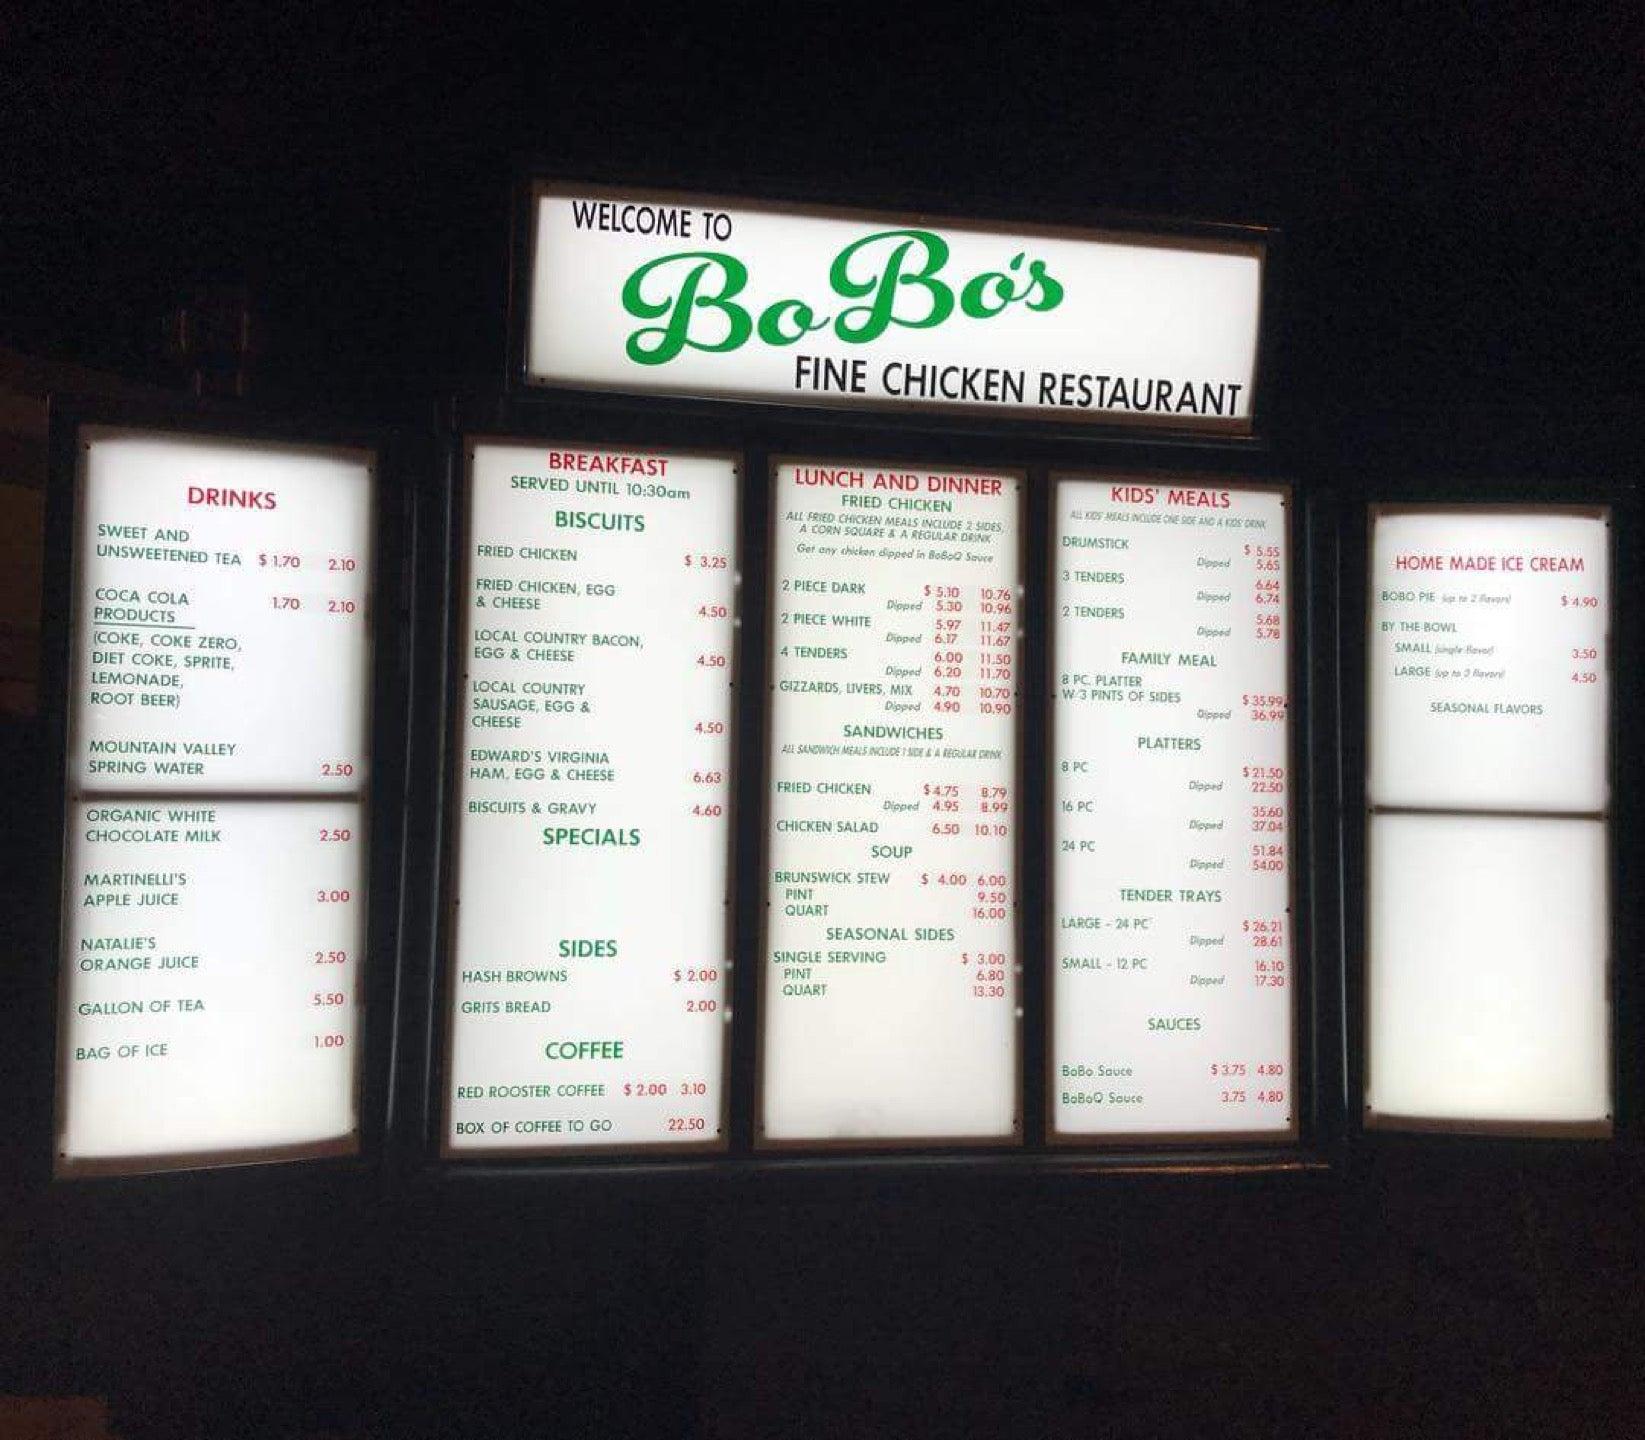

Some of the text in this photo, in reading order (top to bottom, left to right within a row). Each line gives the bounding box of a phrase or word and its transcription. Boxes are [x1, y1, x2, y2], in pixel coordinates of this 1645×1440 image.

[573, 201, 731, 241] WELCOME TO
[622, 230, 1064, 366] BoBo's
[796, 356, 1241, 415] FINE CHICKEN RESTAURANT
[550, 453, 667, 476] BREAKFAST
[512, 476, 690, 498] SERVED UNTIL 10:30am
[796, 469, 1001, 495] LUNCH AND DINNER
[189, 487, 276, 509] DRINKS
[842, 494, 952, 512] FRIED CHICKEN
[1112, 487, 1229, 508] KIDS' MEALS
[556, 511, 644, 532] BISCUITS
[99, 524, 189, 542] SWEET AND
[1063, 536, 1129, 549] DRUMSTICK
[97, 545, 241, 565] UNSWEETENED TEA
[478, 545, 577, 561] FRIED CHICKEN
[329, 559, 355, 571] 2.10
[1256, 559, 1280, 573] 5.65
[1397, 556, 1584, 572] HOME MADE ICE CREAM
[783, 580, 865, 594] 2 PIECE DARK
[96, 588, 189, 605] COCA COLA
[981, 587, 1010, 601] 10.76
[1419, 591, 1435, 602] PIE
[94, 607, 175, 623] PRODUCTS
[1063, 606, 1124, 619] 2 TENDERS
[781, 613, 871, 627] 2 PIECE WHITE
[475, 629, 643, 648] LOCAL COUNTRY BACON,
[781, 646, 847, 659] 4 TENDERS
[1395, 643, 1431, 653] SMALL
[93, 652, 233, 670] DIET COKE, SPRITE,
[697, 655, 725, 666] 4.50
[1122, 652, 1217, 667] FAMILY MEAL
[1395, 665, 1431, 677] LARGE
[92, 672, 183, 688] LEMONADE,
[1062, 674, 1069, 684] 8
[1096, 675, 1142, 687] PLATTER
[1572, 673, 1597, 683] 4.50
[891, 684, 912, 695] MIX
[934, 686, 960, 697] 4.70
[1431, 702, 1543, 715] SEASONAL FLAVORS
[844, 725, 943, 740] SANDWICHES
[90, 741, 236, 756] MOUNTAIN VALLEY
[1138, 737, 1201, 750] PLATTERS
[471, 750, 609, 764] EDWARD'S VIRGINIA
[90, 760, 204, 774] SPRING WATER
[322, 763, 353, 776] 2.50
[693, 772, 721, 783] 6.63
[469, 799, 596, 814] BISCUITS & GRAVY
[87, 809, 215, 823] ORGANIC WHITE
[777, 820, 879, 832] CHICKEN SALAD
[932, 823, 960, 835] 6.50
[975, 824, 1007, 836] 10.10
[86, 830, 220, 842] CHOCOLATE MILK
[320, 829, 350, 841] 2.50
[544, 828, 640, 846] SPECIALS
[871, 846, 912, 858] SOUP
[1063, 841, 1095, 852] 24 PC
[1253, 858, 1283, 871] 54.00
[84, 873, 186, 886] MARTINELLI'S
[775, 872, 889, 884] BRUNSWICK STEW
[978, 875, 1007, 888] 6.00
[84, 893, 178, 907] APPLE JUICE
[786, 888, 812, 900] PINT
[1121, 889, 1221, 902] TENDER TRAYS
[785, 905, 829, 916] QUART
[1062, 917, 1101, 929] LARGE
[827, 928, 954, 940] SEASONAL SIDES
[81, 937, 155, 951] NATALIE'S
[559, 940, 617, 957] SIDES
[79, 956, 198, 971] ORANGE JUICE
[774, 951, 886, 963] SINGLE SERVING
[1062, 957, 1101, 969] SMALL
[1255, 960, 1284, 972] 16.10
[463, 970, 567, 983] HASH BROWNS
[973, 985, 1004, 997] 13.30
[315, 993, 343, 1006] 5.50
[687, 1000, 716, 1012] 2.00
[79, 1000, 204, 1016] GALLON OF TEA
[462, 1001, 551, 1014] GRITS BREAD
[1148, 1018, 1201, 1030] SAUCES
[545, 1041, 623, 1059] COFFEE
[1062, 1065, 1132, 1079] BoBo Sauce
[1258, 1065, 1283, 1076] 4.80
[458, 1085, 605, 1099] RED ROOSTER COFFEE
[1109, 1090, 1142, 1103] Sauce
[457, 1120, 612, 1134] BOX OF COFFEE TO GO
[669, 1118, 704, 1131] 22.50
